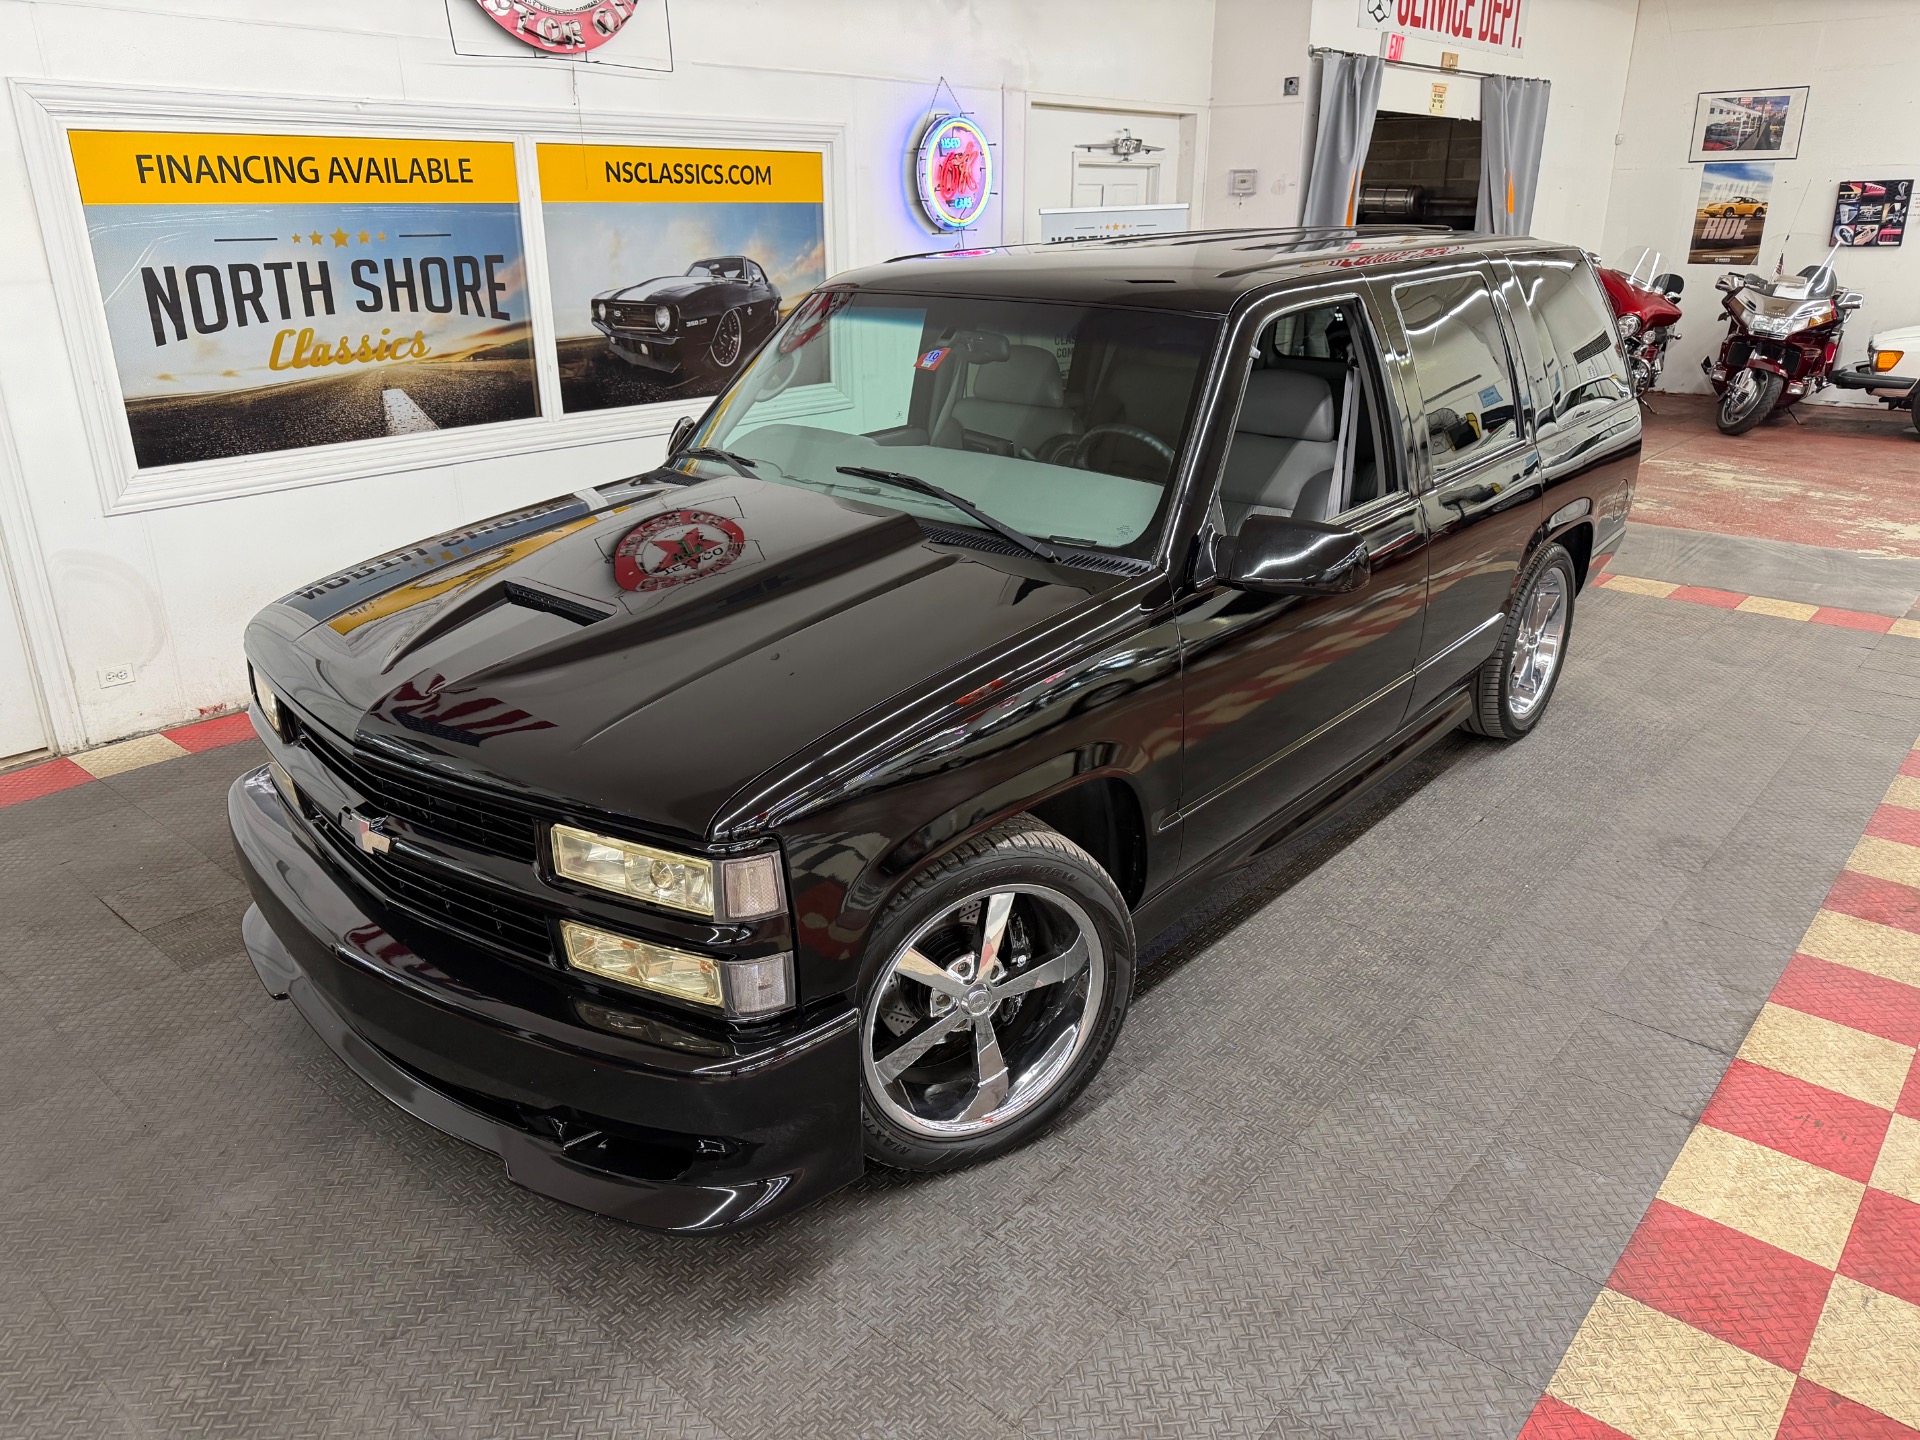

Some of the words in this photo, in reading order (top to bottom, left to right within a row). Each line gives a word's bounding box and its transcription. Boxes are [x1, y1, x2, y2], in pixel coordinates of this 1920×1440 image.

[482, 0, 587, 49] OTOR
[1388, 34, 1405, 61] EXIT
[135, 153, 320, 185] FINANCING
[328, 156, 474, 184] AVAILABLE
[605, 161, 772, 186] NSCLASSICS.COM
[1701, 217, 1751, 240] RIDE
[140, 260, 336, 348] NORTH
[350, 254, 512, 322] SHORE
[268, 328, 432, 371] Classics
[928, 350, 941, 361] 10
